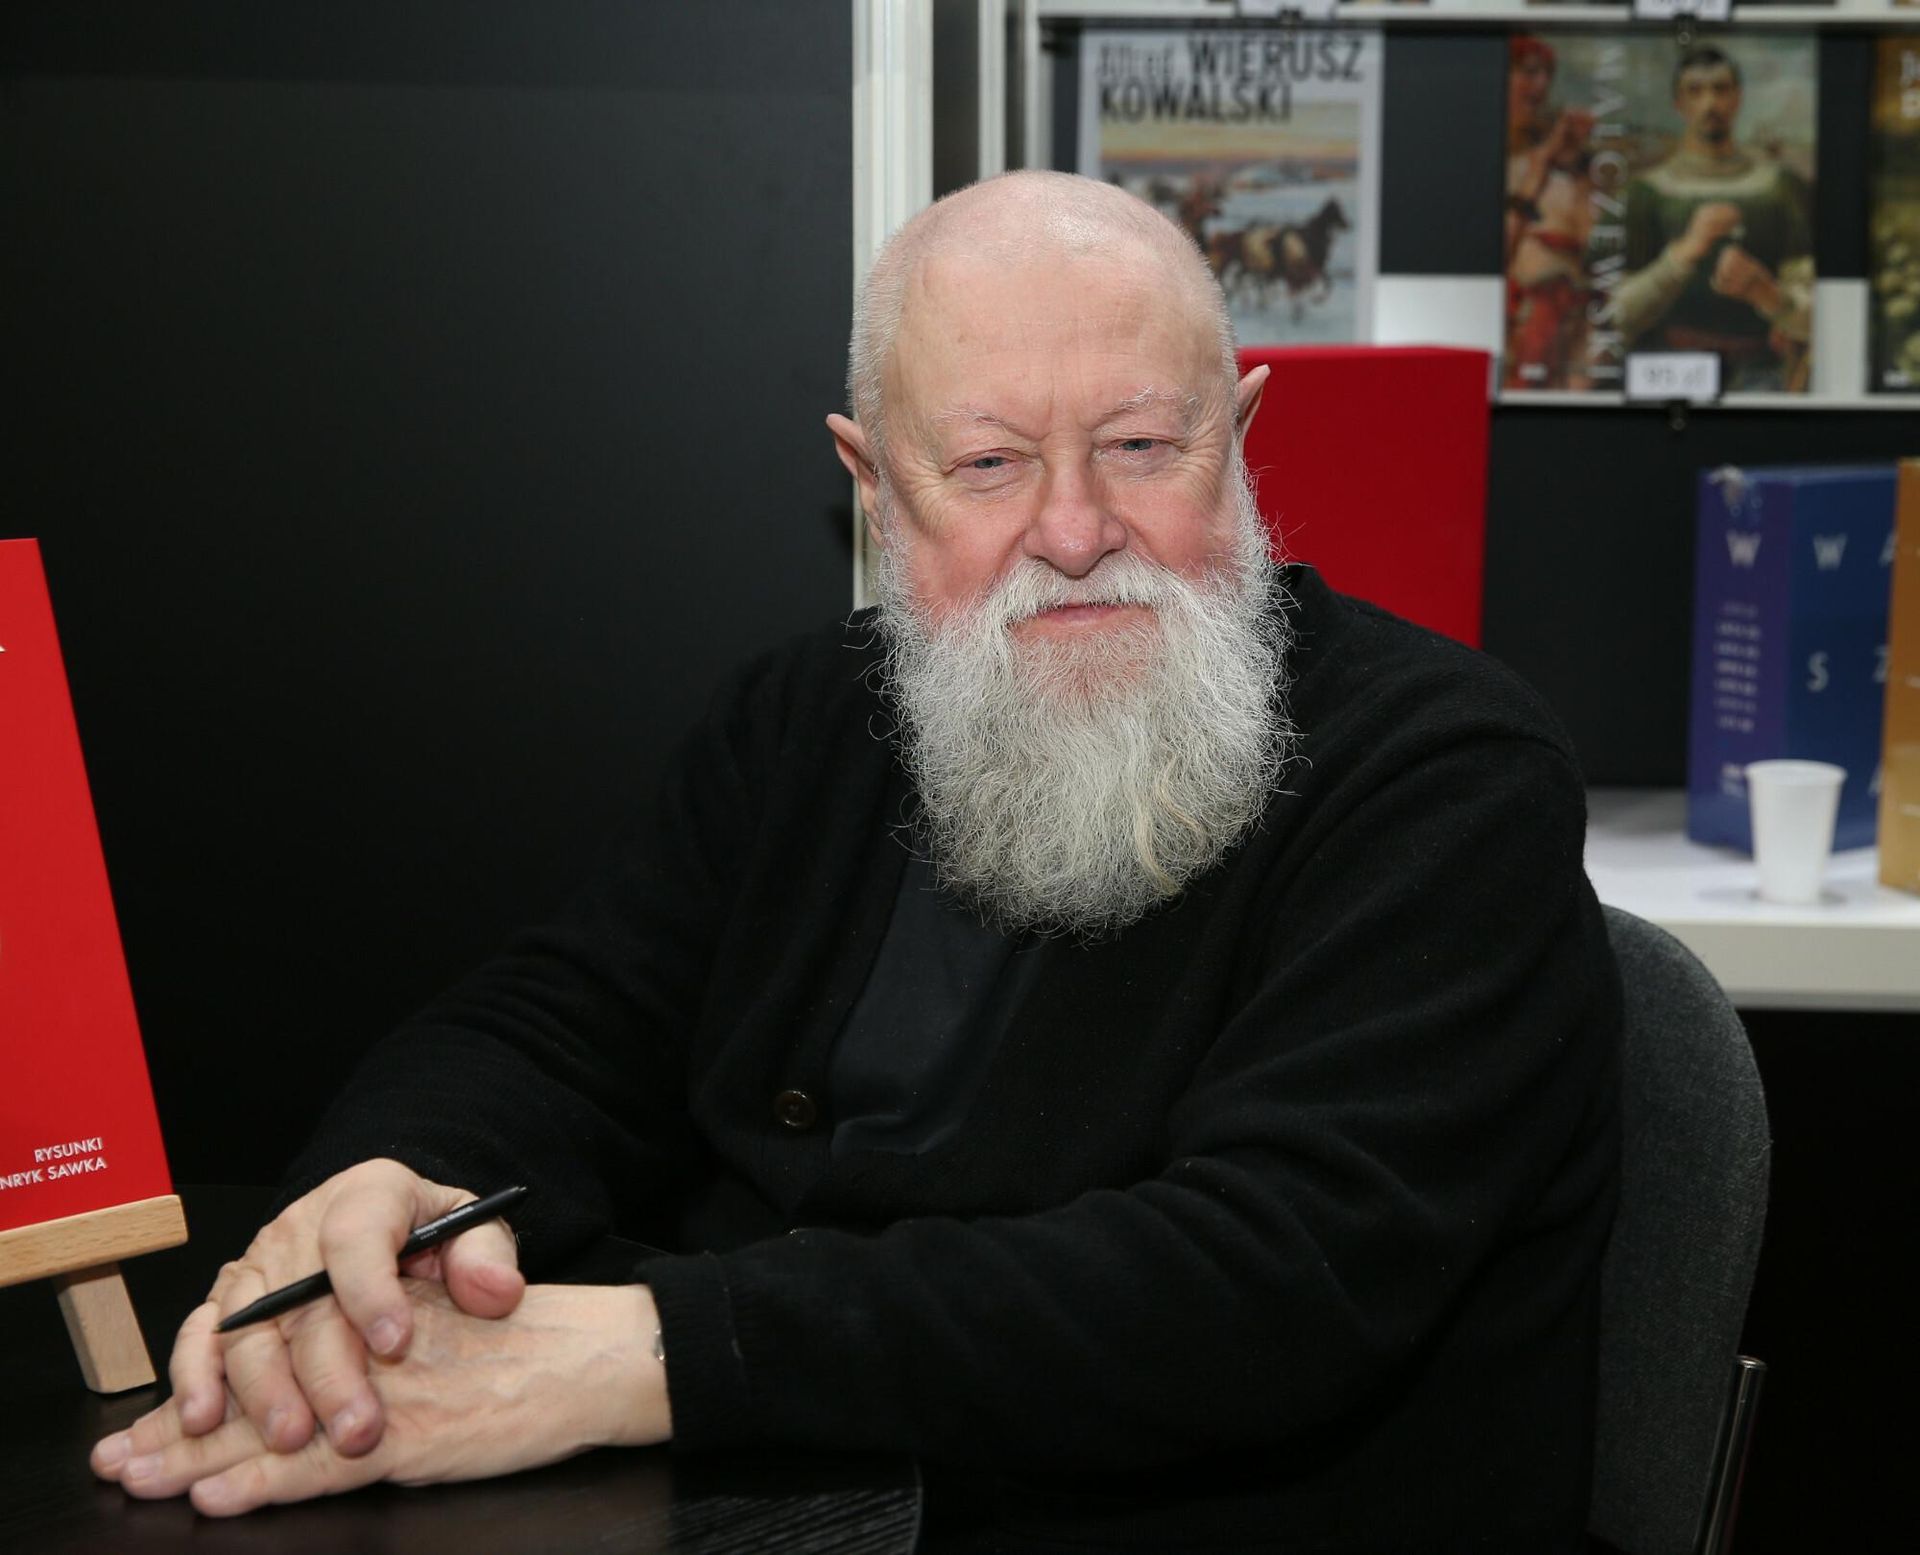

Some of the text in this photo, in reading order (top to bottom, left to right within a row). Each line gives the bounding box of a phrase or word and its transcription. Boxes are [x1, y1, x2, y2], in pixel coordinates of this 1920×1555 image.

[1188, 32, 1364, 82] WIERUSZ
[1100, 78, 1291, 122] KOWALSKI
[34, 1137, 103, 1162] RYSUNKI
[47, 1157, 107, 1180] SAWKA
